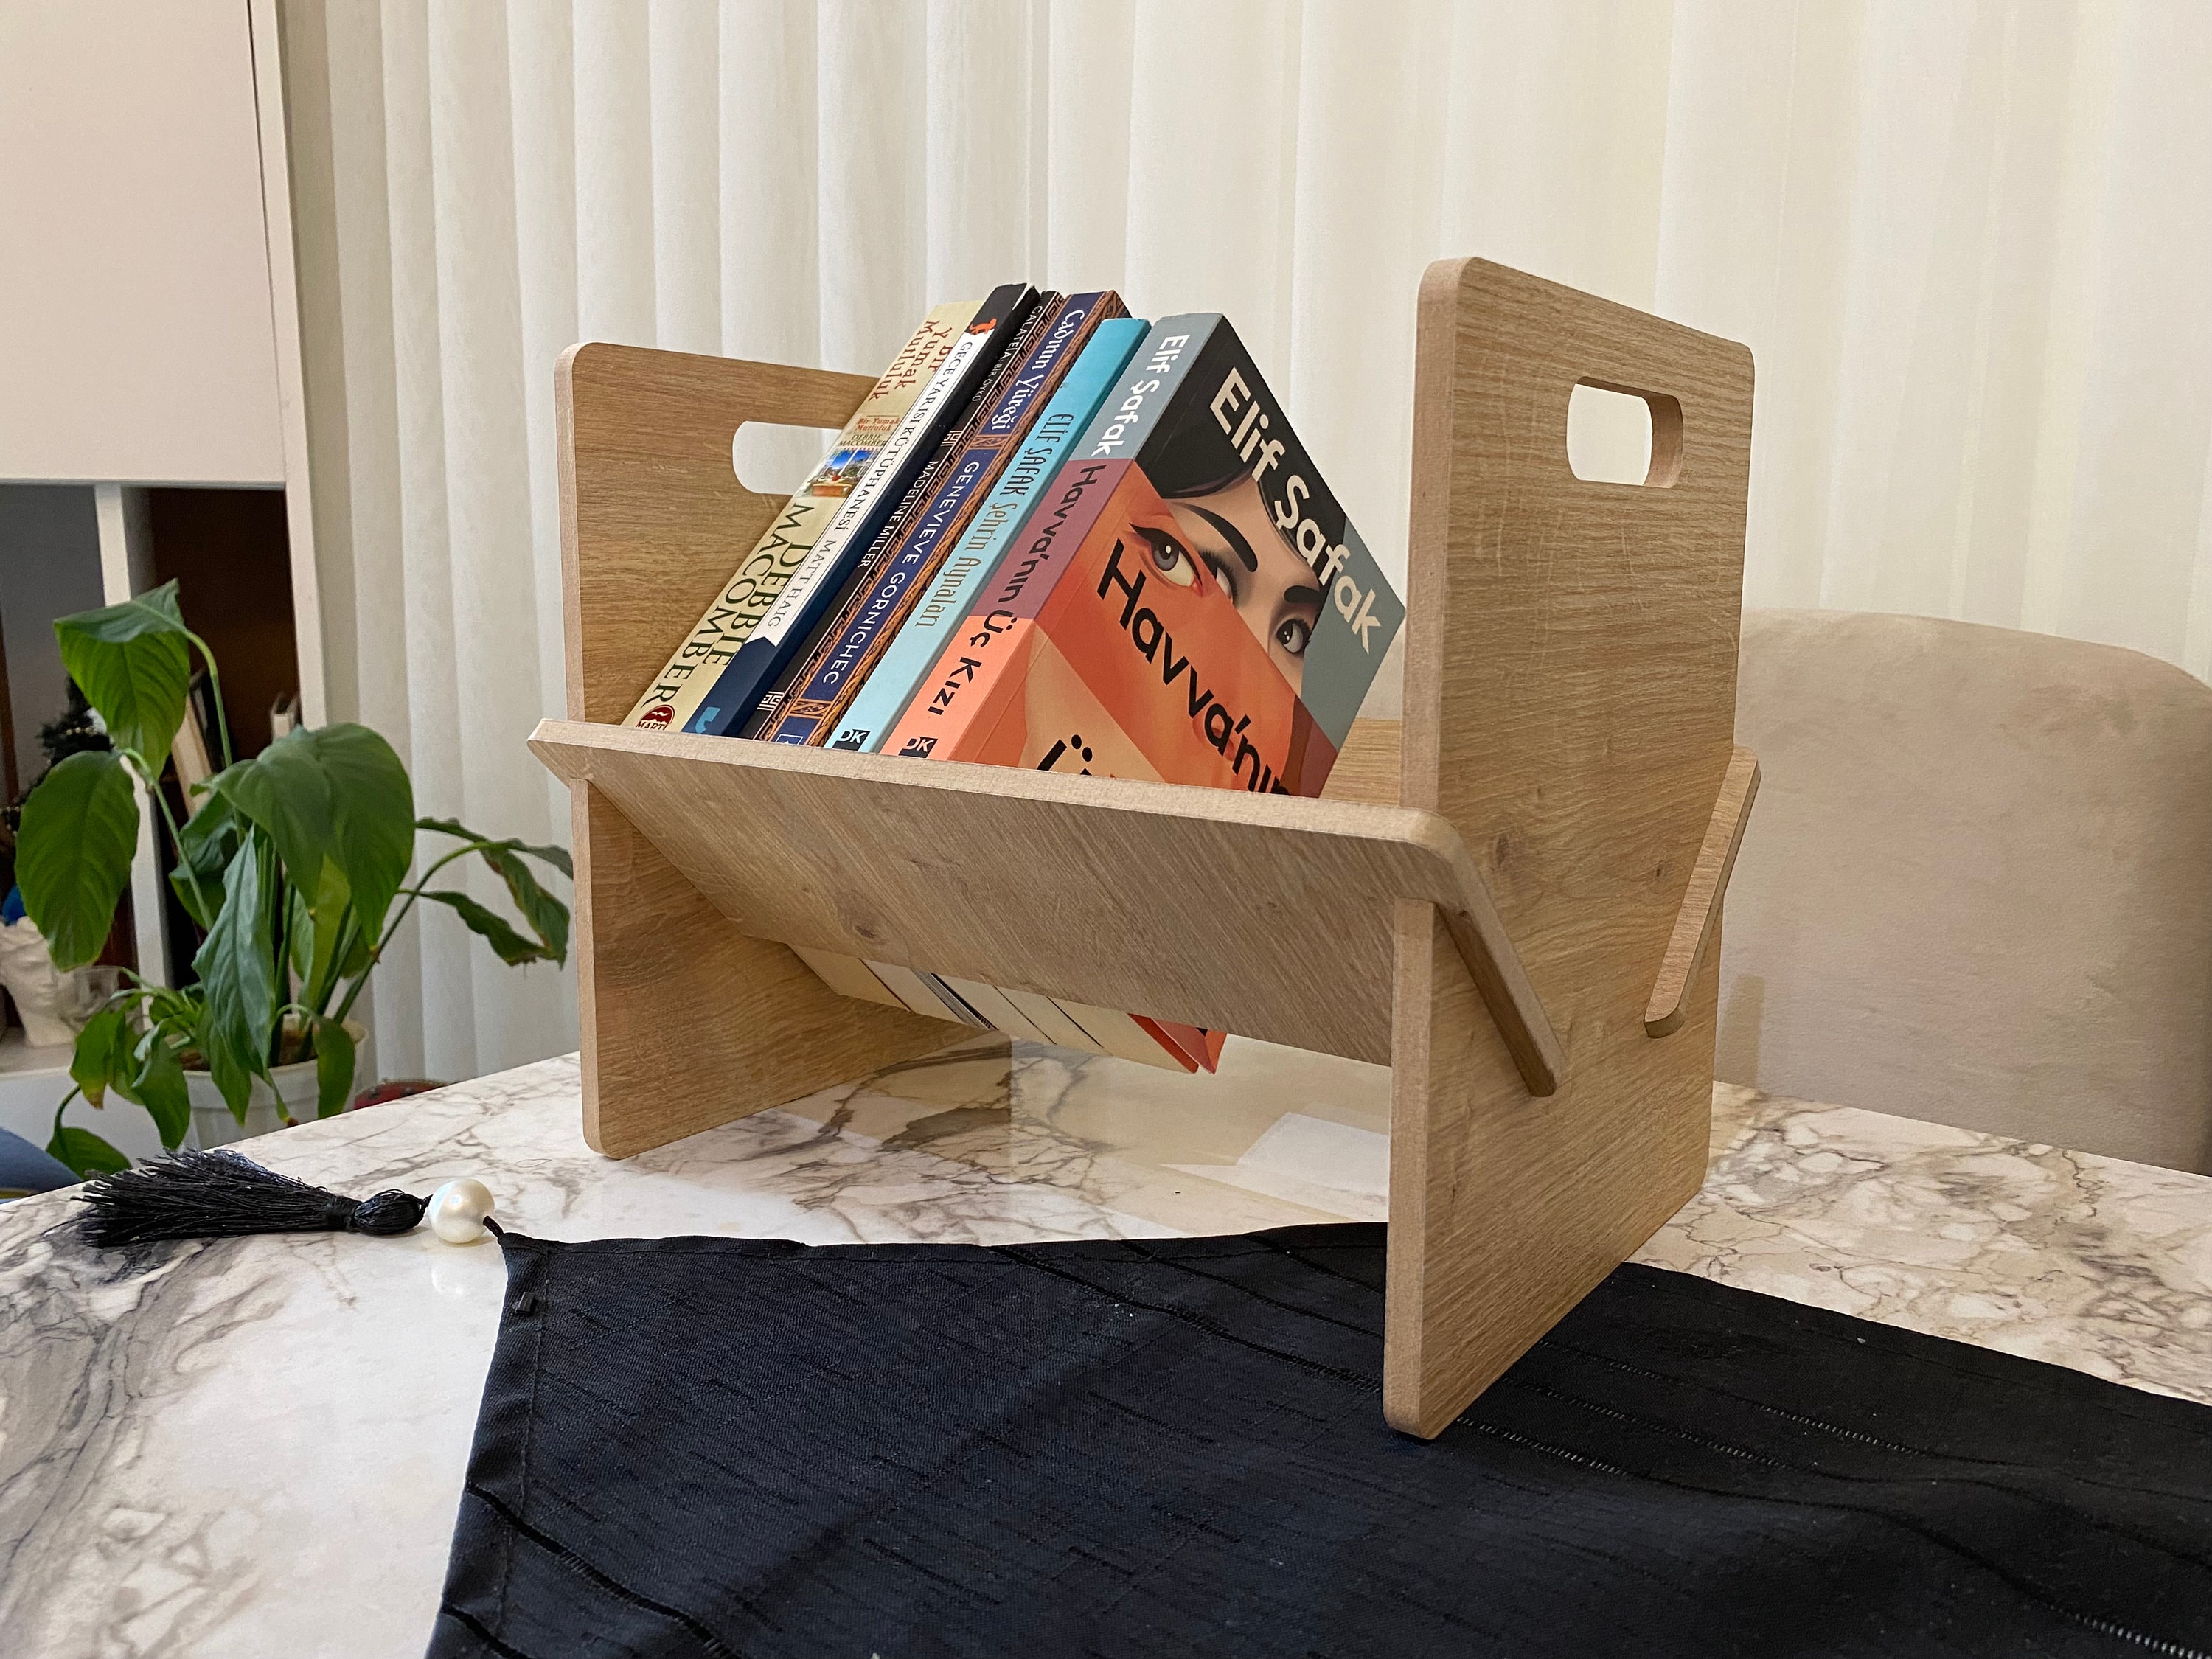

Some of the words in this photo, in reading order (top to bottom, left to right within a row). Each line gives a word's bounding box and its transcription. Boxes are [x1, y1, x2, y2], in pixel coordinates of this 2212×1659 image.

[868, 320, 940, 401] Mutluluk
[894, 327, 952, 389] Yumak
[927, 345, 953, 372] Bir
[943, 341, 973, 375] GECE
[1031, 309, 1085, 370] Cadının
[1145, 335, 1191, 374] Elif
[909, 378, 950, 423] YARISI
[991, 374, 1045, 431] Yüreği
[1035, 413, 1074, 443] ELİF
[1091, 379, 1161, 457] Şafak
[834, 426, 916, 532] KÜTÜPHANESİ
[888, 461, 939, 523] MADELINE
[999, 448, 1053, 496] ŞAFAK
[902, 462, 980, 565] GENEVIEVE
[964, 502, 1018, 551] Şehrin
[997, 465, 1107, 603] Havva'nın
[1210, 366, 1286, 483] Elif
[1274, 474, 1382, 655] Şafak
[799, 540, 836, 584] MATT
[857, 526, 894, 568] MILLER
[640, 502, 814, 708] MACOMBER
[702, 542, 814, 665] DEBBIE
[767, 588, 803, 627] HAIG
[915, 557, 982, 627] Aynaları
[823, 571, 906, 684] GORNICHEC
[970, 609, 1018, 648] Üç
[927, 656, 983, 716] Kızı
[835, 729, 869, 746] DK
[902, 737, 936, 754] DK
